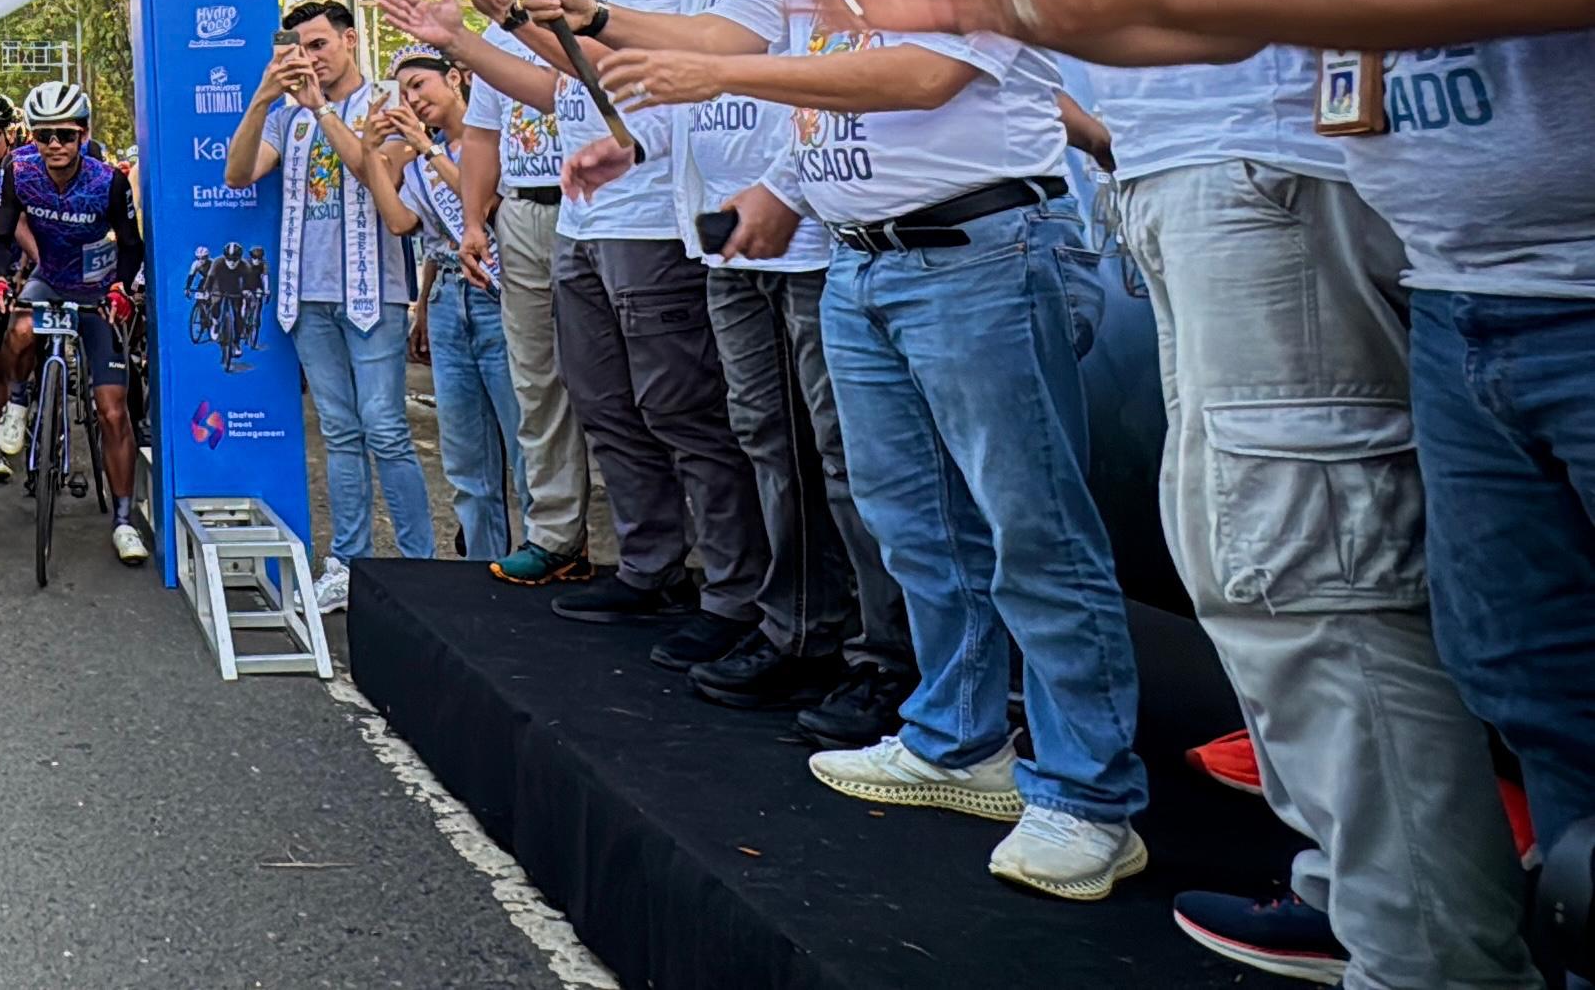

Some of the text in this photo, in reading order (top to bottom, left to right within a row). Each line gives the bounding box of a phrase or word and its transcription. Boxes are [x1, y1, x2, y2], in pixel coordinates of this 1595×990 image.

[196, 6, 237, 23] Hydro
[195, 91, 244, 114] ULTIMATE
[193, 183, 258, 199] Entrasol
[26, 205, 97, 224] KOTA BARU
[357, 233, 368, 297] SELATAN
[42, 312, 72, 329] 514
[229, 430, 285, 438] Management
